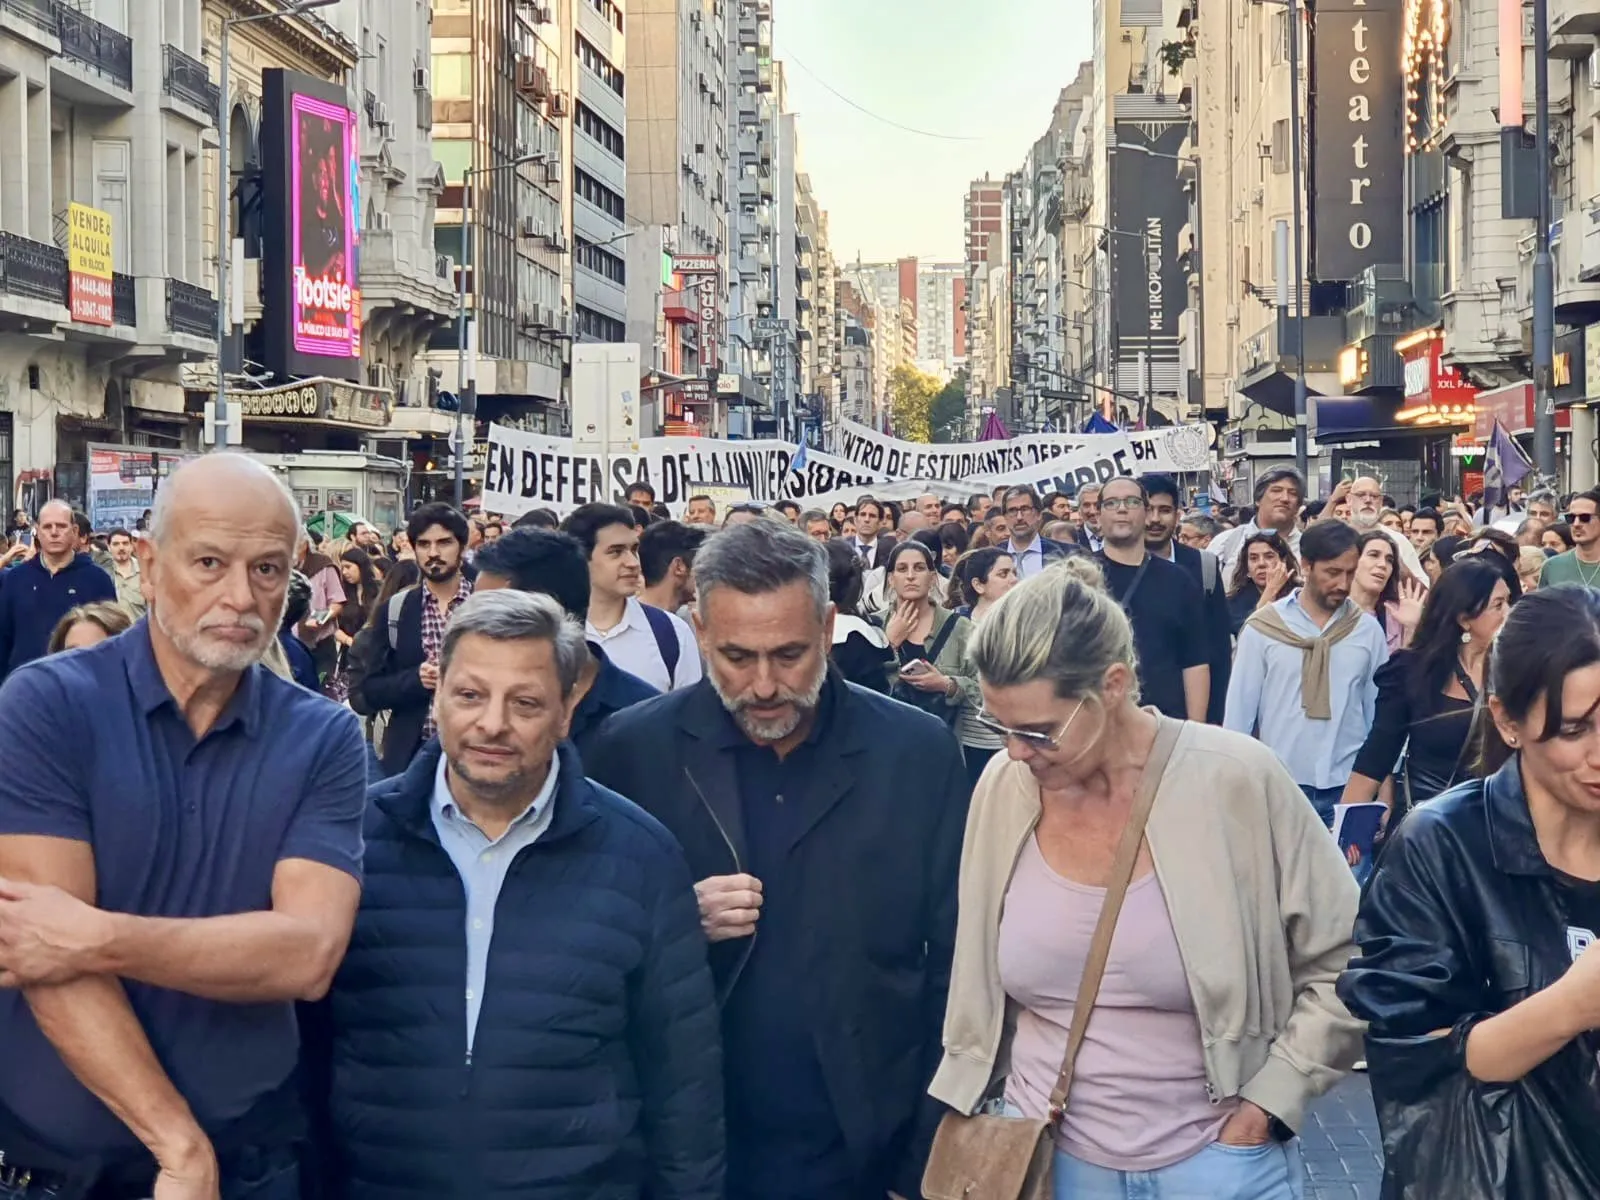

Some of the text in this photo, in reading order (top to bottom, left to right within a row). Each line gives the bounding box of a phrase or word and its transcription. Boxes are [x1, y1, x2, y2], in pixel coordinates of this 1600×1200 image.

[1348, 18, 1371, 249] teatro
[72, 210, 105, 234] VENDE
[72, 233, 111, 258] ALQUILA
[673, 259, 716, 270] PIZZERIA
[292, 266, 352, 312] Tootsie
[758, 320, 787, 329] CINE
[1437, 380, 1455, 389] XXL
[484, 441, 514, 494] EN
[521, 450, 650, 506] DEFENSA
[886, 449, 911, 477] DE
[914, 446, 1024, 481] ESTUDIANTES
